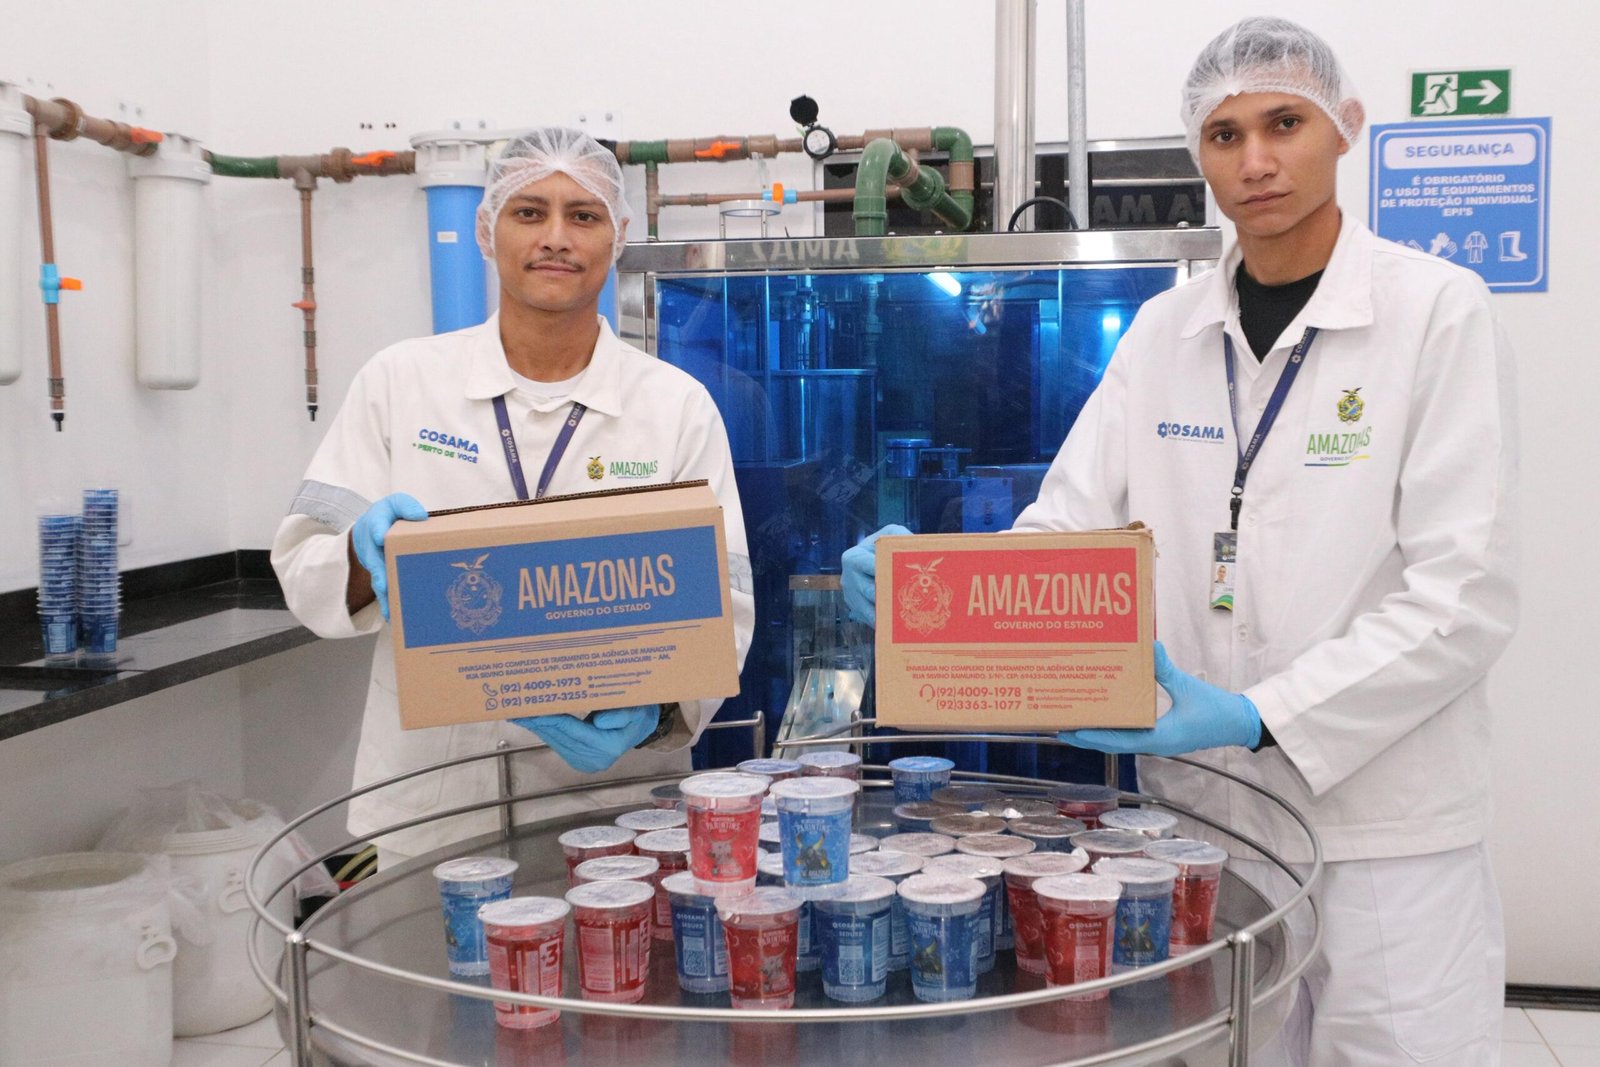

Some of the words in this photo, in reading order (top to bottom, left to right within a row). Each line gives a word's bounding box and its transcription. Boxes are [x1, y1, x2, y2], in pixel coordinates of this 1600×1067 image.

[1405, 142, 1515, 158] SEGURANÇA
[1412, 175, 1421, 185] É
[1423, 173, 1506, 184] OBRIGATÓRIO
[1383, 188, 1393, 197] O
[1395, 187, 1421, 197] USO
[1424, 186, 1439, 195] DE
[1442, 184, 1535, 195] EQUIPAMENTOS
[1380, 198, 1397, 208] DE
[1399, 196, 1463, 207] PROTEÇÃO
[418, 428, 479, 455] COSAMA
[506, 436, 518, 464] COSAMA
[418, 443, 443, 455] PERTO
[444, 450, 455, 458] DE
[457, 452, 479, 464] VOCÊ
[609, 460, 659, 476] AMAZONAS
[518, 553, 676, 610] AMAZONAS
[967, 572, 1132, 617] AMAZONAS
[545, 608, 594, 621] GOVERNO
[596, 605, 611, 616] DO
[613, 602, 651, 614] ESTADO
[993, 620, 1044, 630] GOVERNO
[1046, 620, 1062, 630] DO
[1064, 620, 1104, 630] ESTADO
[505, 658, 540, 667] COMPLEXO
[500, 682, 521, 694] (92)
[523, 677, 581, 691] 4009-1973
[501, 696, 522, 709] (92)
[524, 690, 588, 705] 98527-3255
